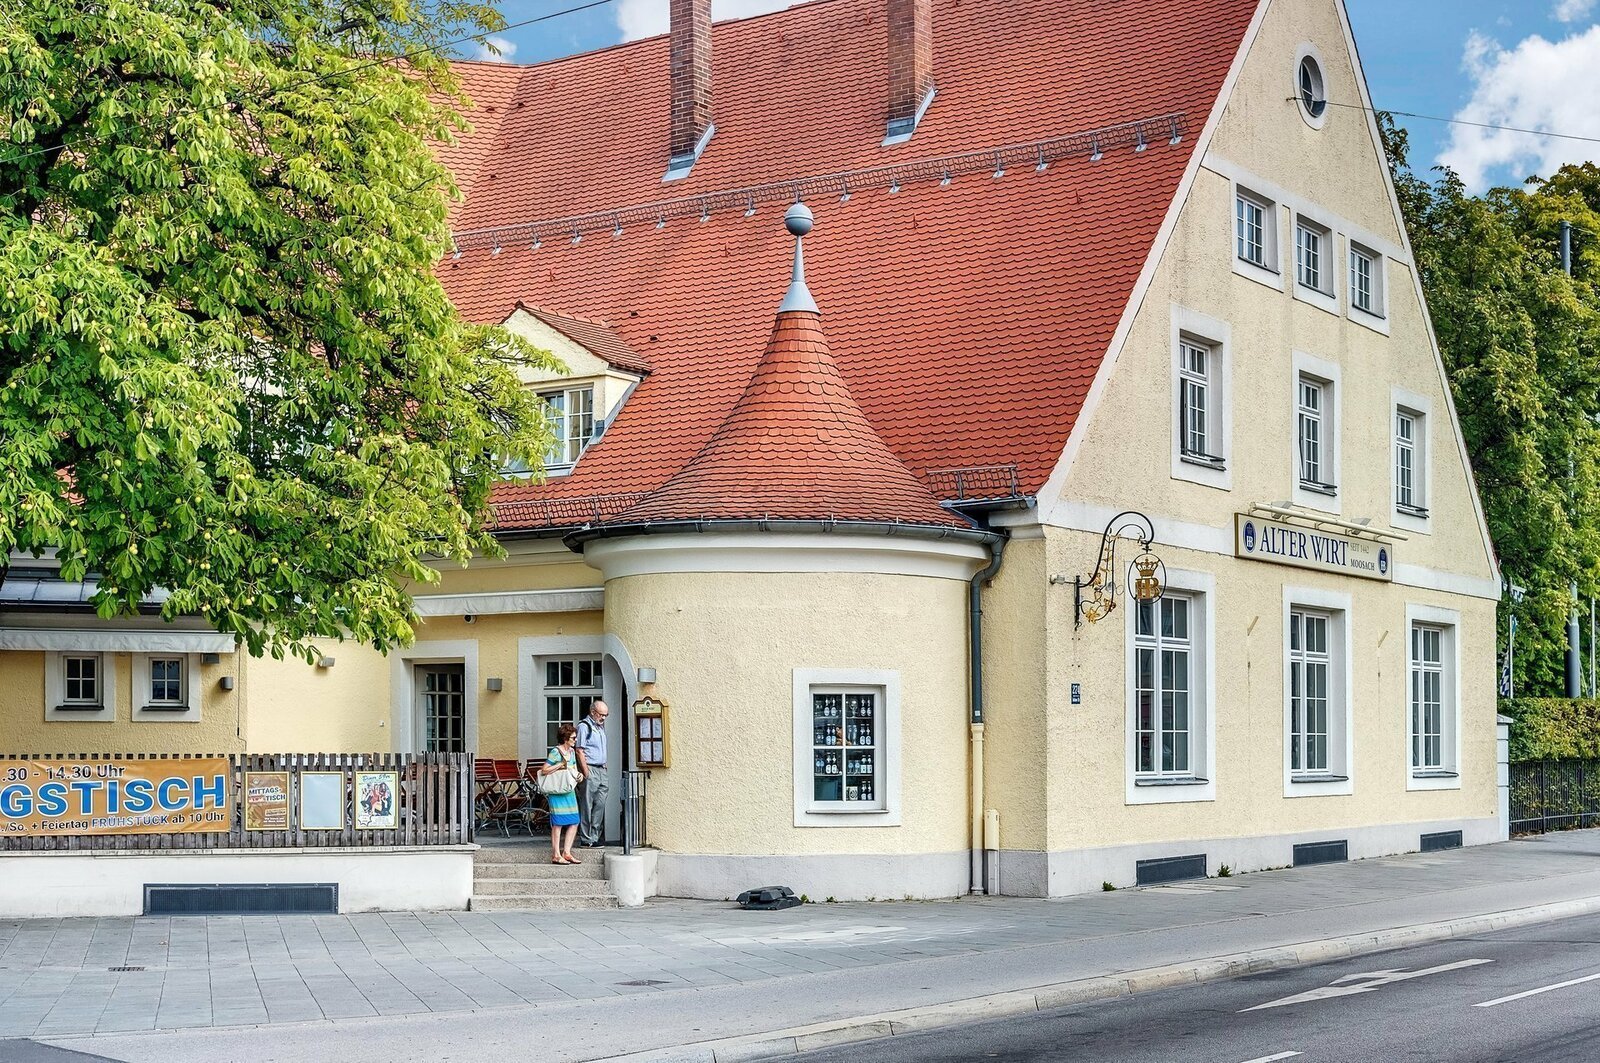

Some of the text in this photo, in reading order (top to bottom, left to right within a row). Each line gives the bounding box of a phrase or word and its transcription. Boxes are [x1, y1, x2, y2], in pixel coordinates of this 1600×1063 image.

[1260, 525, 1349, 566] ALTER WIRT
[1350, 558, 1375, 571] MOOSACH
[46, 766, 92, 780] 14.30
[97, 764, 125, 778] Uhr
[0, 774, 226, 819] GSTISCH
[248, 787, 281, 795] MITTAGS-
[41, 820, 88, 831] Feiertag
[92, 815, 168, 828] FRÜHSTÜCK
[172, 815, 185, 823] ab
[189, 813, 202, 822] 10
[206, 812, 224, 821] Uhr
